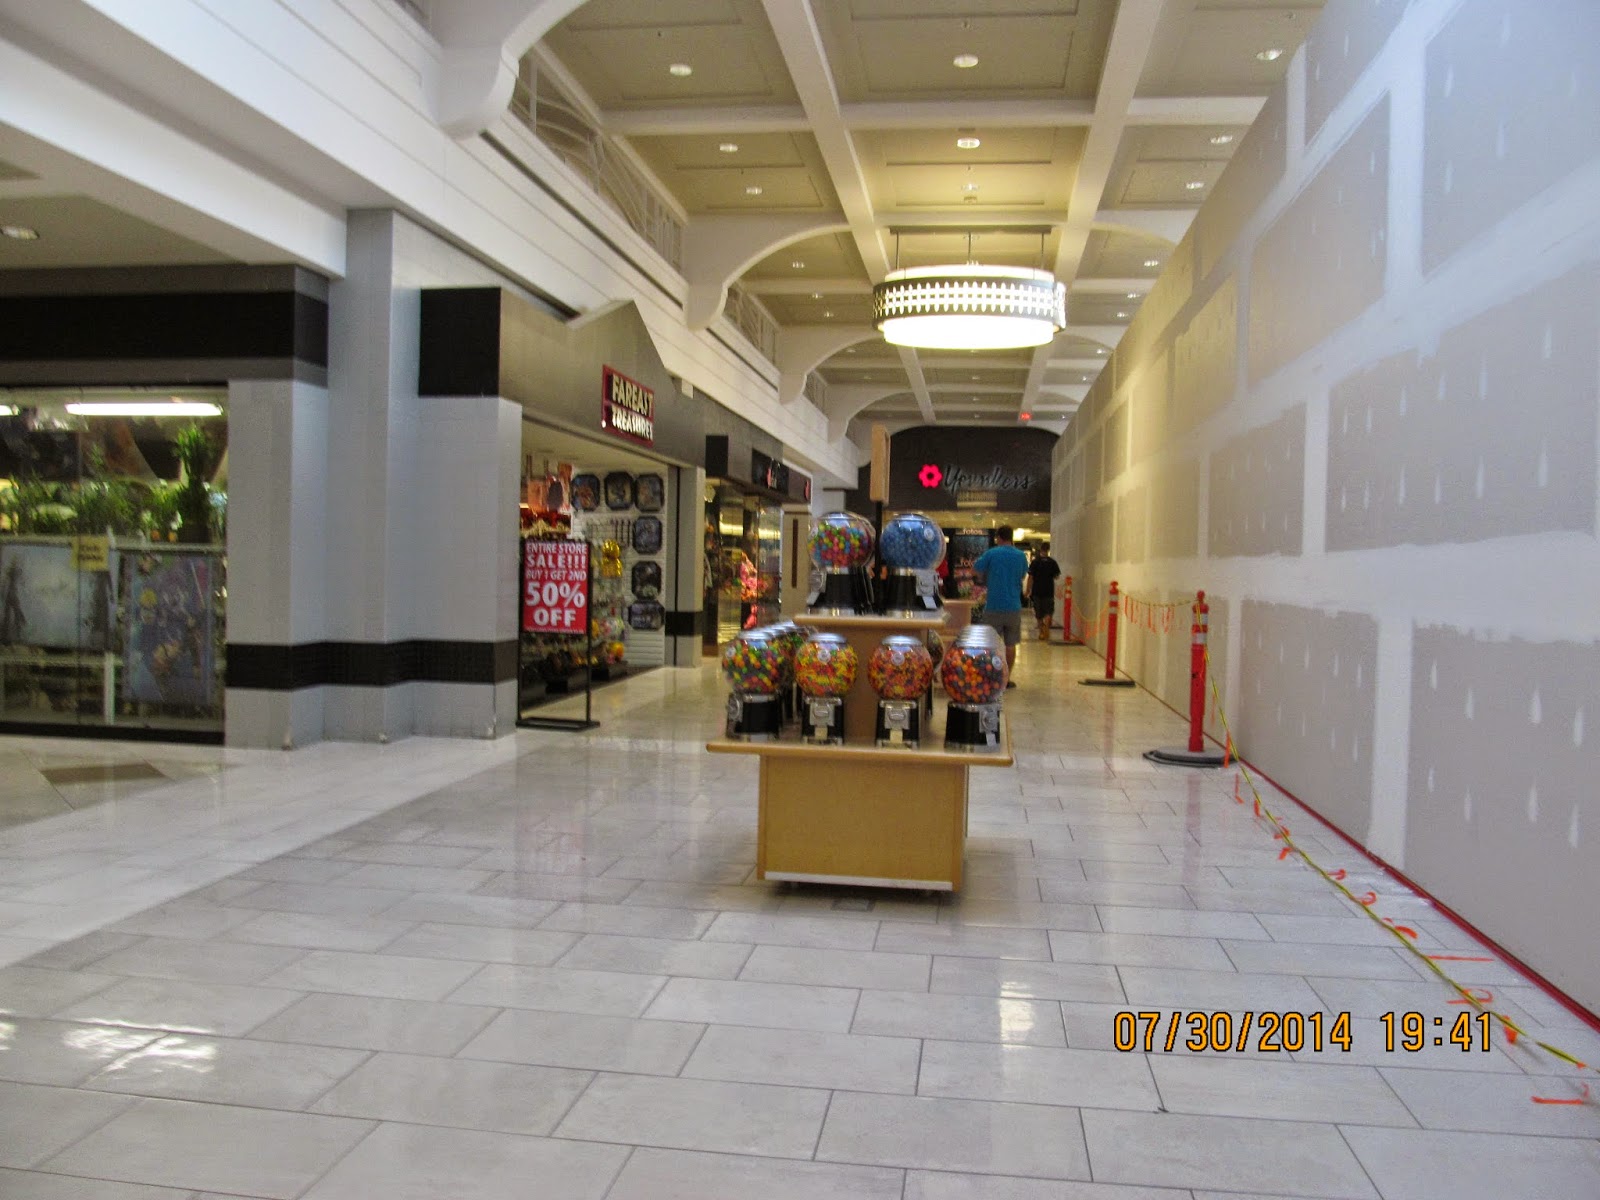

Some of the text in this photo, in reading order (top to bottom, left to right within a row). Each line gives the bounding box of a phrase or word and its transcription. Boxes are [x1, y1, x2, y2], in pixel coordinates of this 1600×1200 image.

[612, 405, 653, 441] TREASURES
[527, 543, 587, 554] ENTIRE STORE
[527, 555, 586, 568] SALE!!!
[527, 570, 542, 579] BUY
[551, 570, 566, 580] GET
[569, 571, 586, 581] 2ND
[526, 582, 585, 608] 50%
[534, 608, 576, 626] OFF
